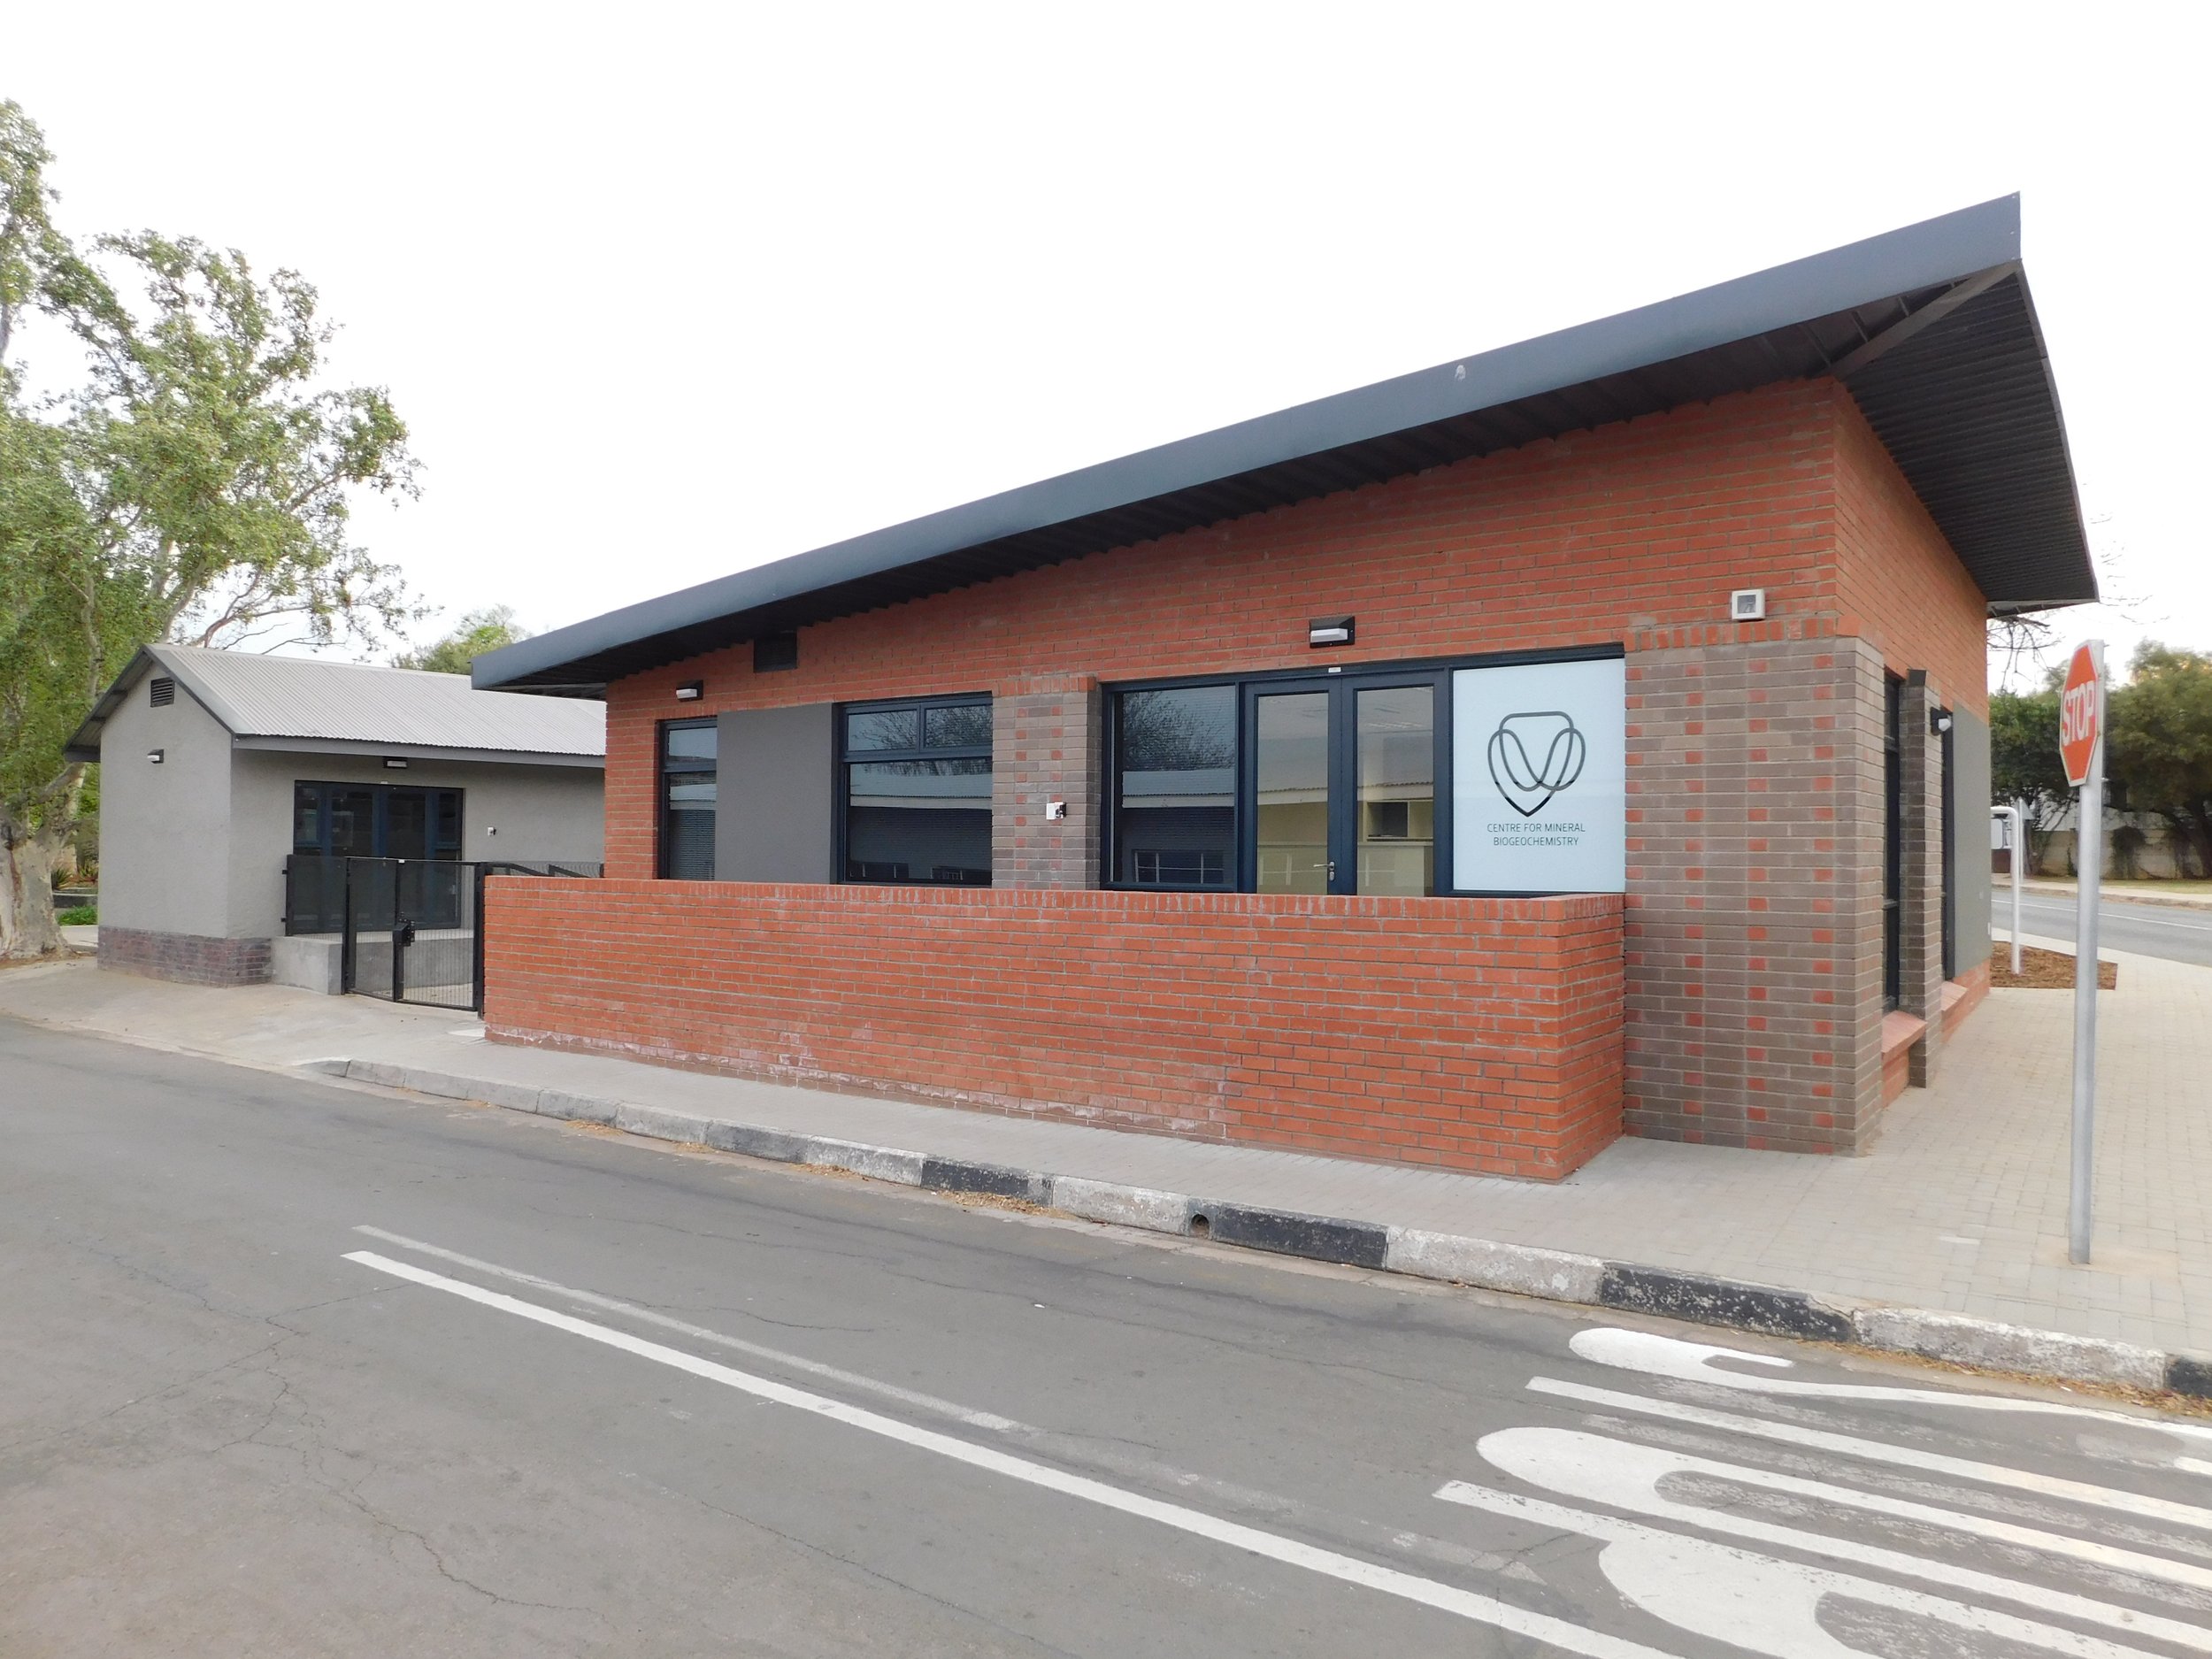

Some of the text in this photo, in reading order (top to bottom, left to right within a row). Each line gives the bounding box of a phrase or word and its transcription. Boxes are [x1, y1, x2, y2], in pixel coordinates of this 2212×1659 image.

[2062, 680, 2095, 747] STOP
[1486, 823, 1586, 833] CENTRE FOR MINERAL
[1493, 836, 1579, 846] BIOGEOCHEMISTRY
